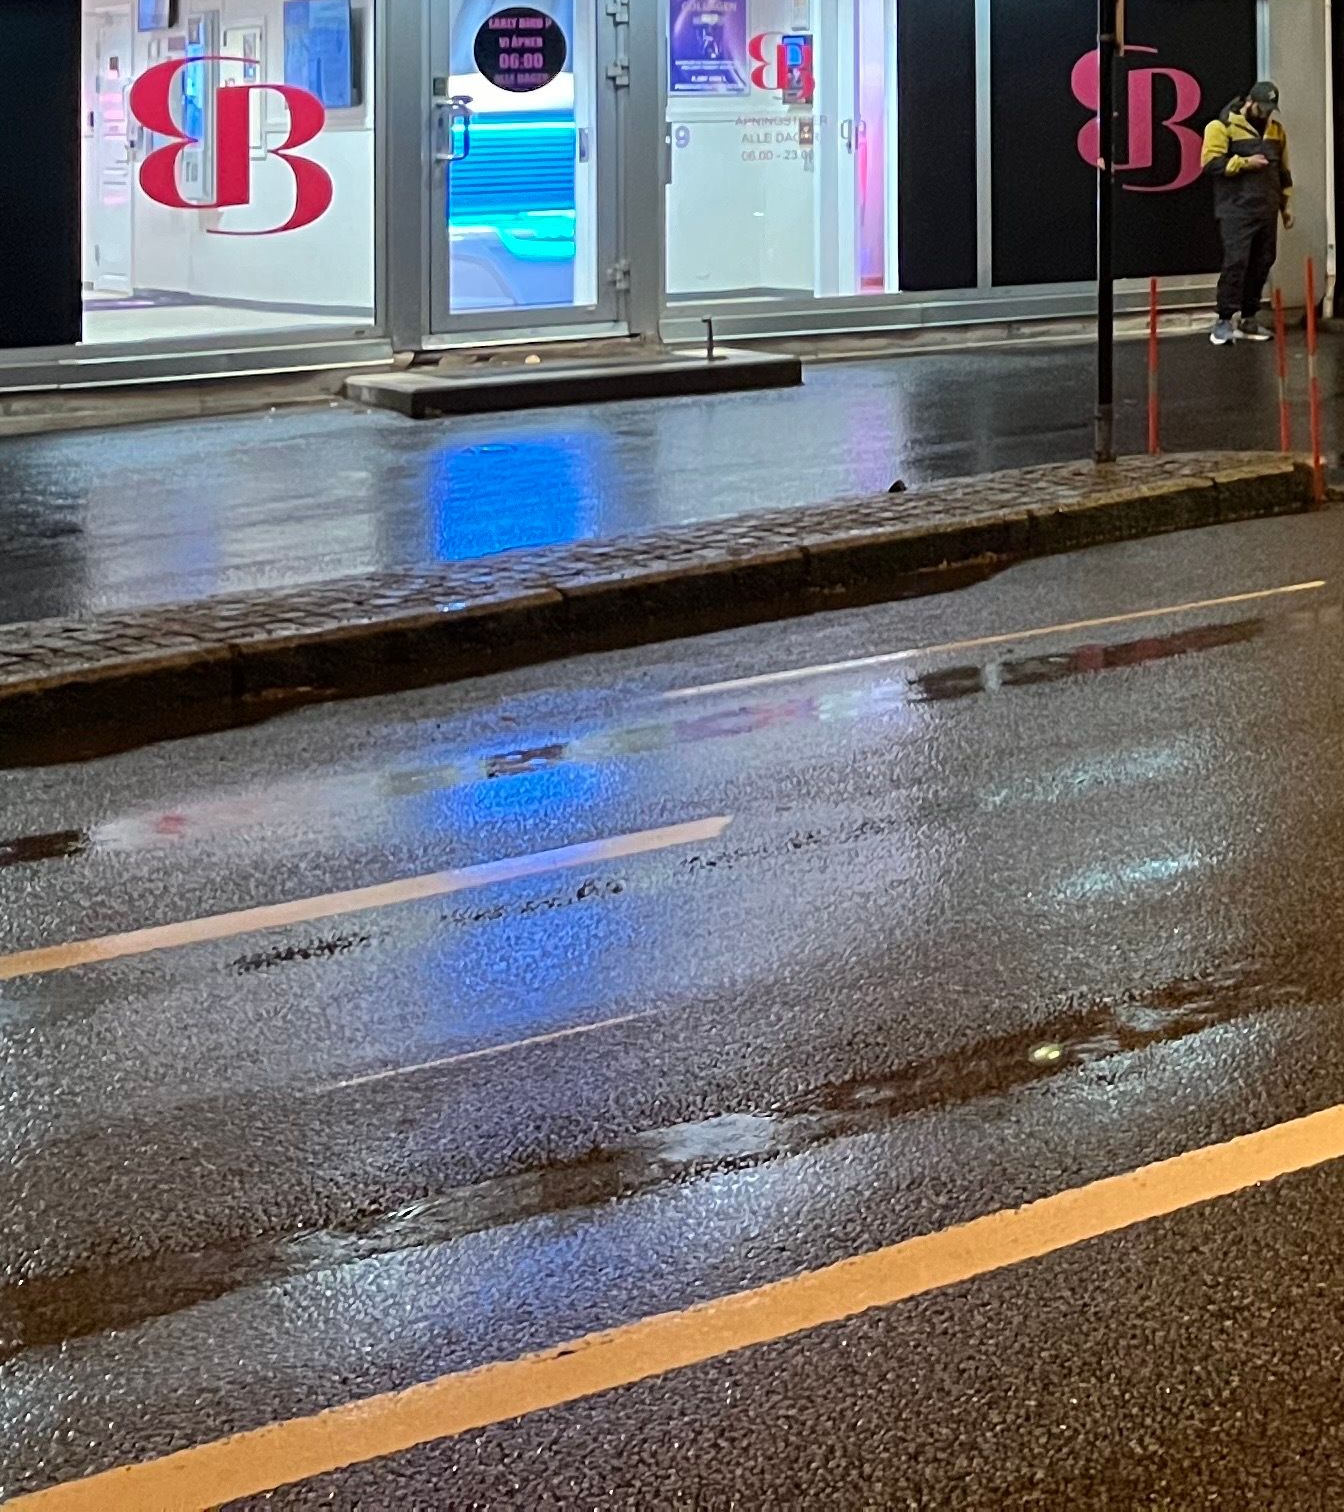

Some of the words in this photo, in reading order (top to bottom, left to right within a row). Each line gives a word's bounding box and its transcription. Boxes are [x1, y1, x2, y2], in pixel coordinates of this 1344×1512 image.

[499, 53, 543, 69] 06:00
[735, 113, 828, 126] ÅPNINGSTER
[741, 133, 772, 144] ALLE
[774, 133, 819, 144] DAGR
